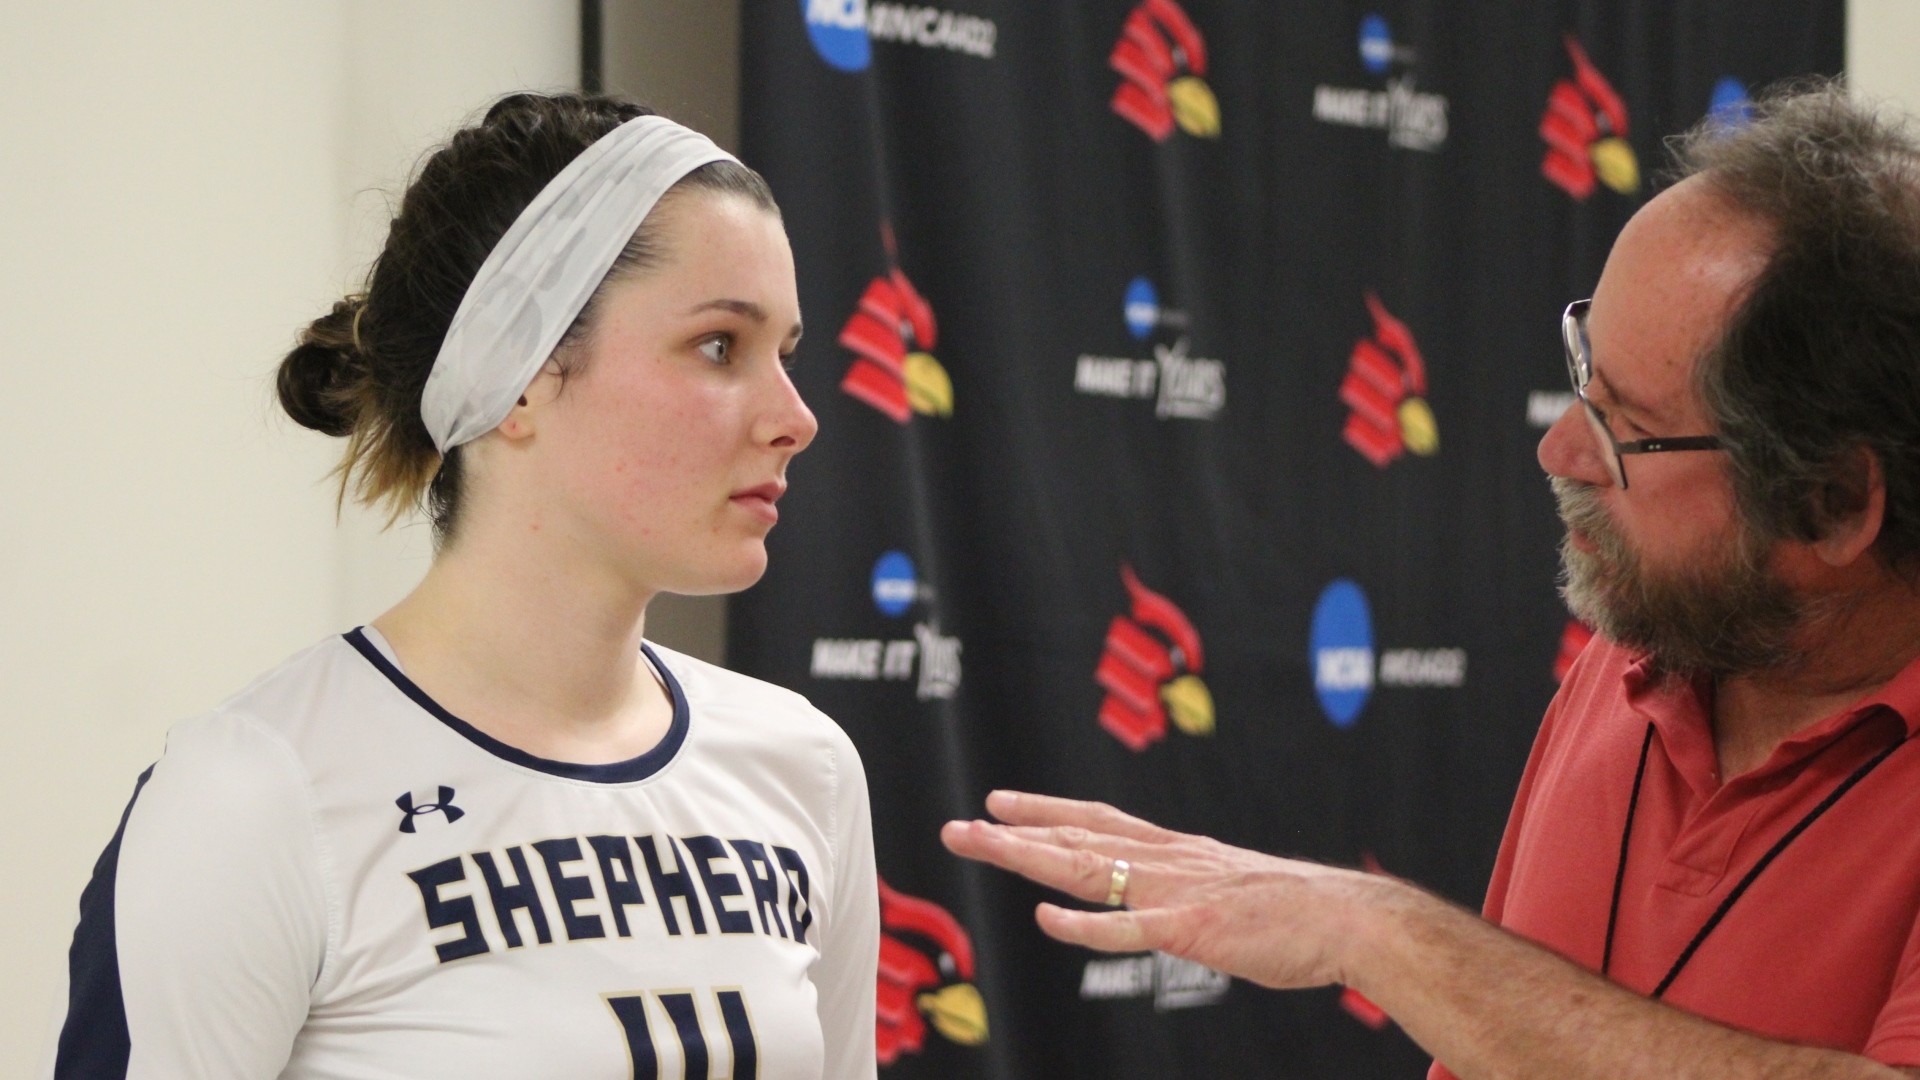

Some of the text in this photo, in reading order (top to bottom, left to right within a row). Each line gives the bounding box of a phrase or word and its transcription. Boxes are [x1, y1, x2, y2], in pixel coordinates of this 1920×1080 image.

[1075, 355, 1131, 397] MAKE
[811, 638, 881, 679] MAKE
[884, 640, 916, 680] IT
[403, 833, 813, 965] SHEPHERD
